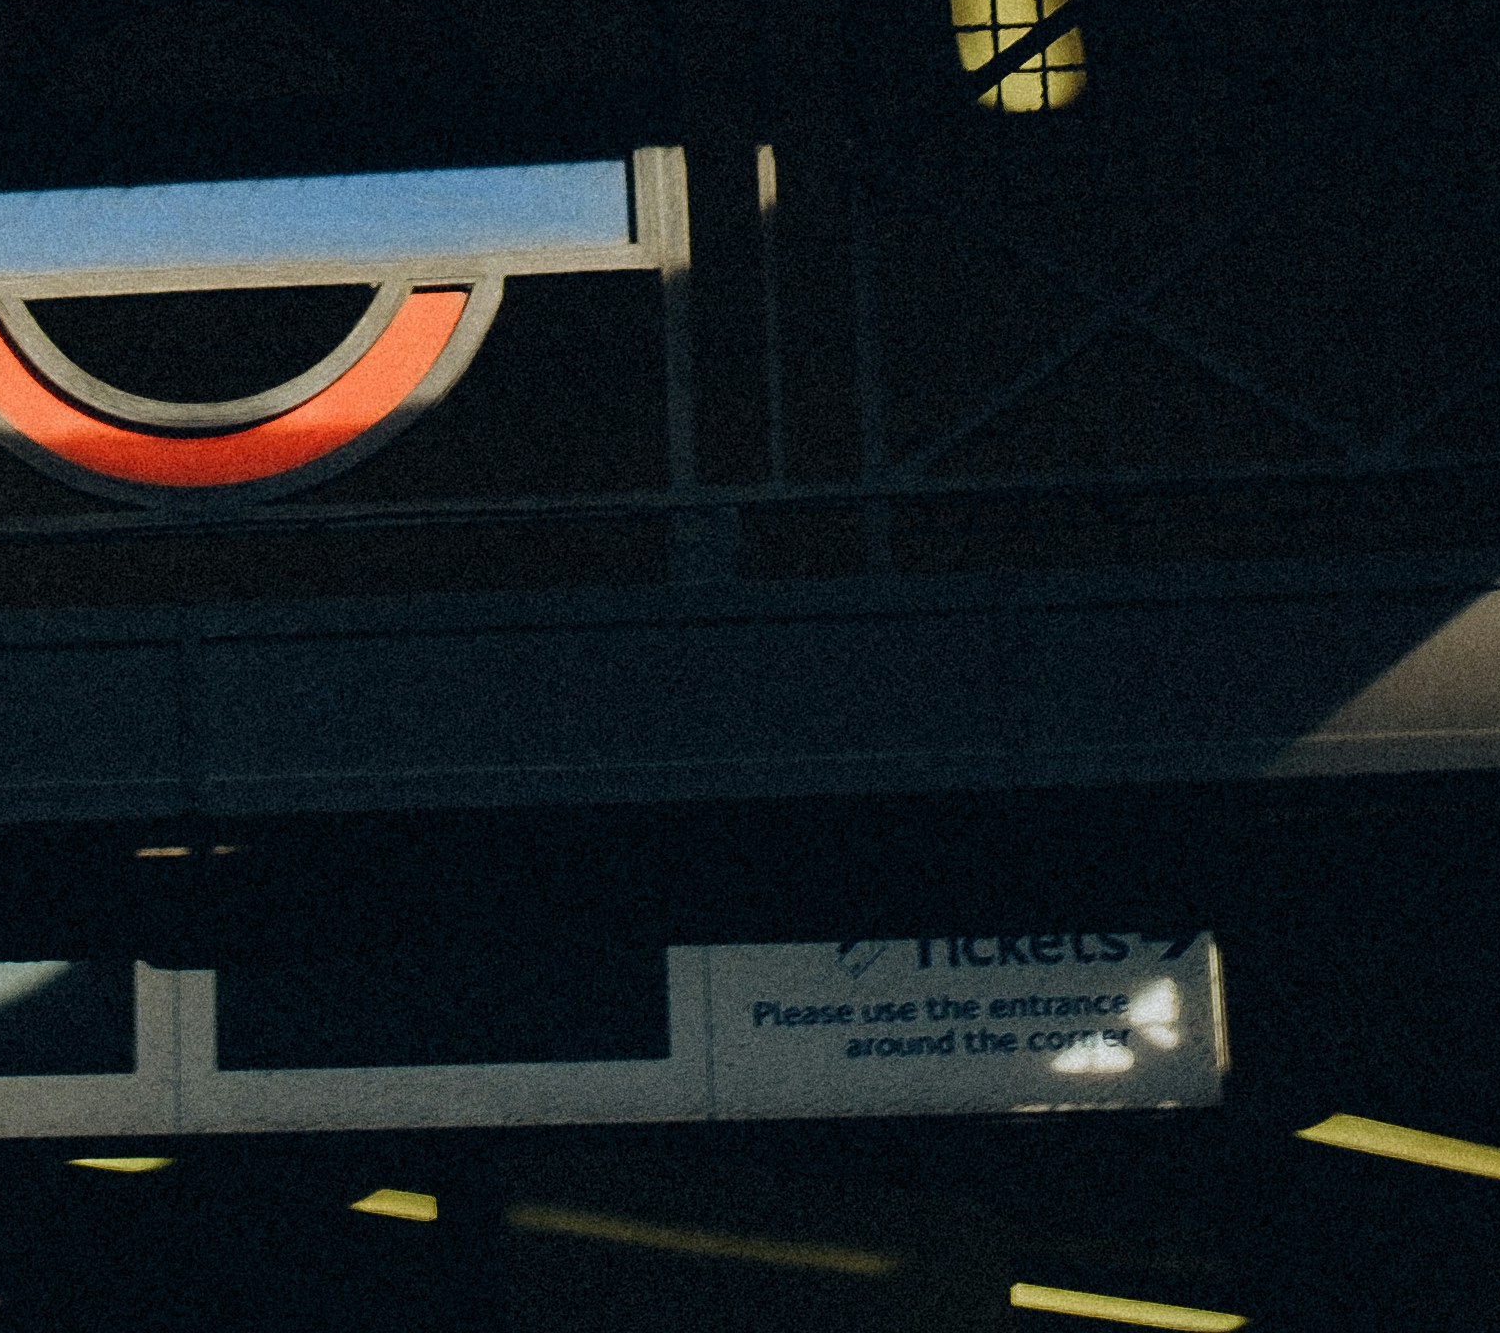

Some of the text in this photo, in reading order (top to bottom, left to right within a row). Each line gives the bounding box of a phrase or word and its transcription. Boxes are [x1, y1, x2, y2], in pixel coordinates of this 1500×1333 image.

[752, 991, 1129, 1027] Please use the entrance
[846, 1030, 956, 1058] around
[964, 1028, 1017, 1054] the
